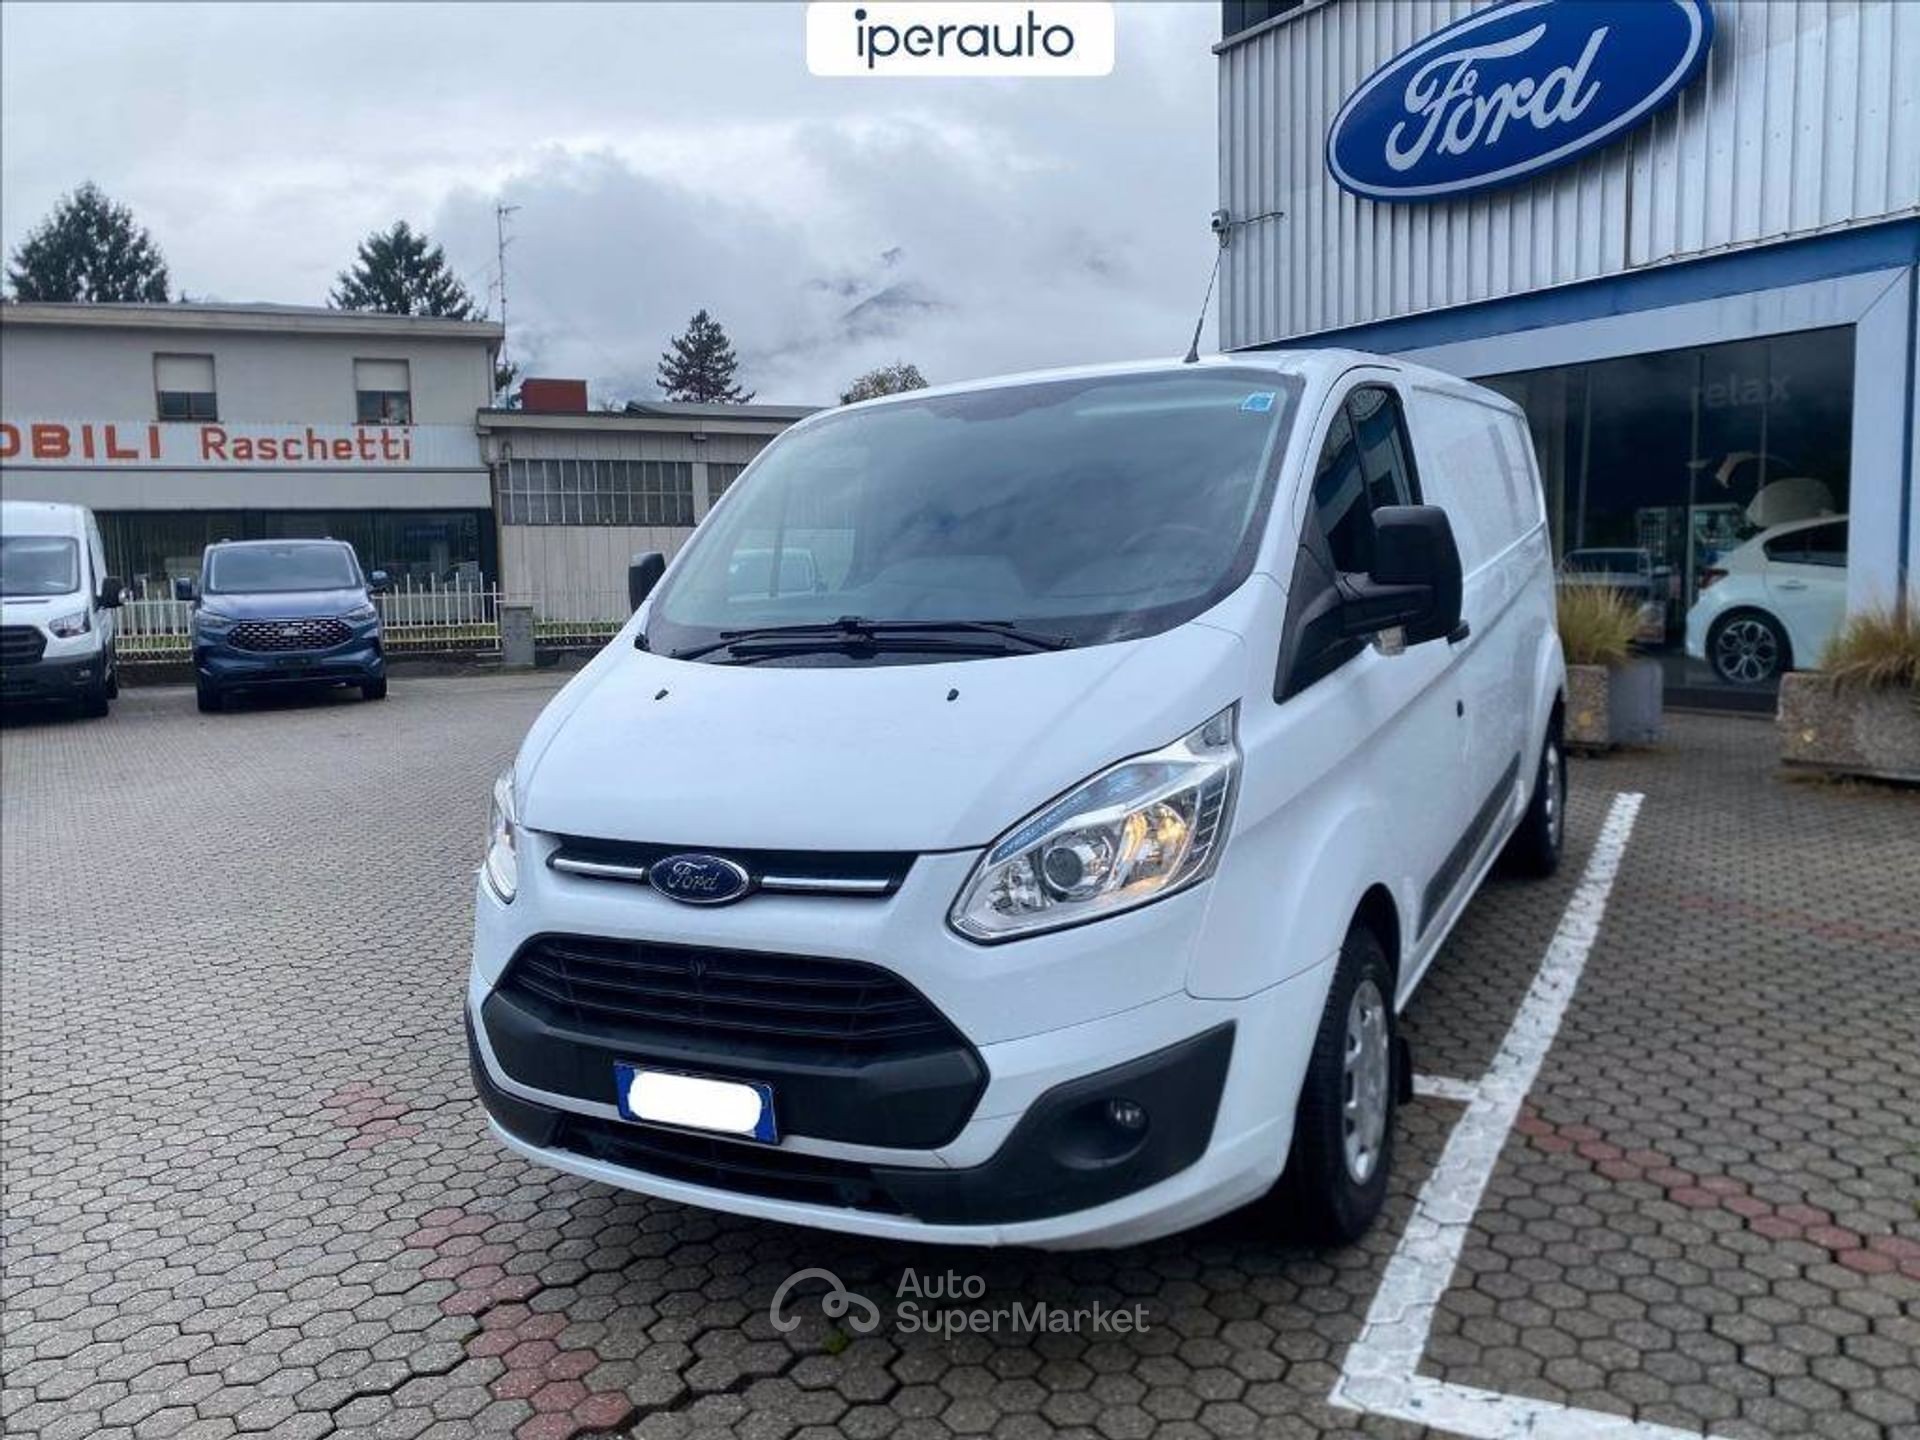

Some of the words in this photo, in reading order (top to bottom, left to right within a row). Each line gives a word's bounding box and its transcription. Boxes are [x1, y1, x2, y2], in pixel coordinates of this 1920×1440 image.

[1386, 23, 1609, 171] Ford
[201, 427, 411, 461] Raschetti
[667, 861, 720, 890] Ford
